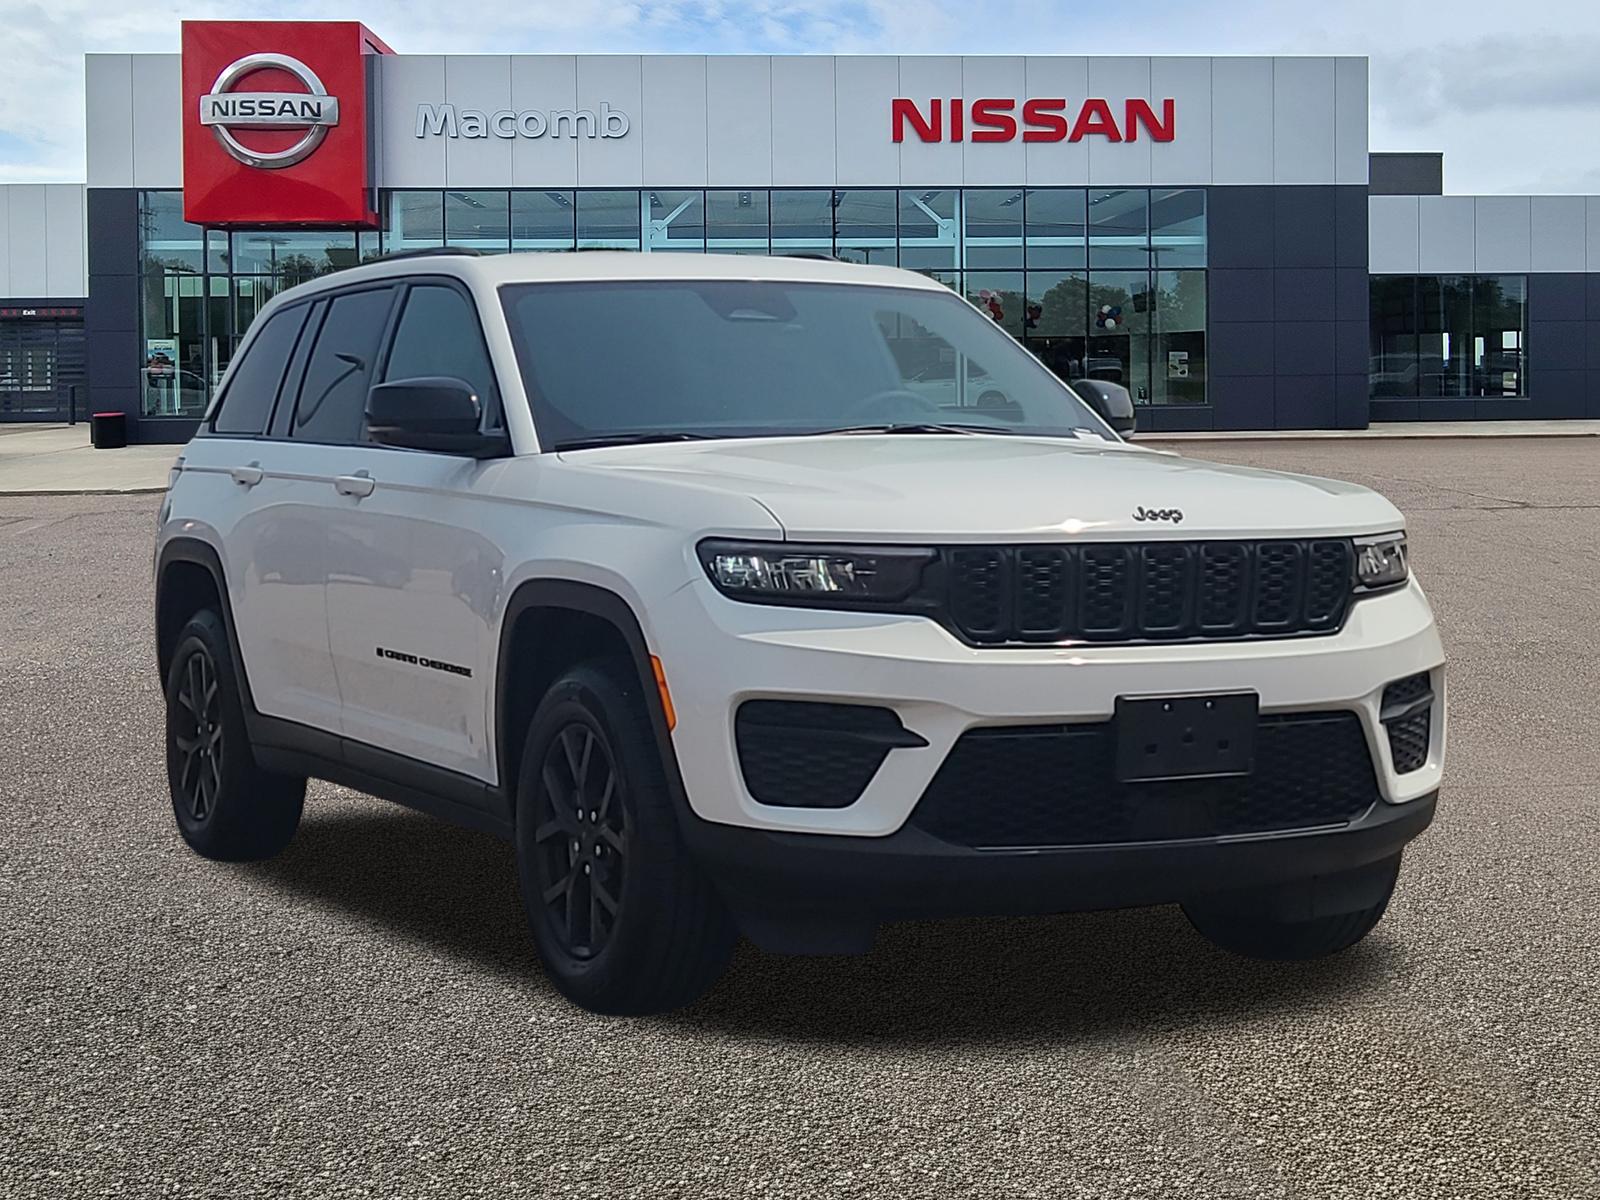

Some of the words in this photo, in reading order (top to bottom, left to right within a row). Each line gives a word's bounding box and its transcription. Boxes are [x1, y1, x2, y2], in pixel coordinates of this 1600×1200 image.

[211, 100, 322, 118] NISSAN
[415, 102, 630, 138] Macomb
[892, 98, 1176, 143] NISSAN
[1132, 506, 1184, 524] Jeep
